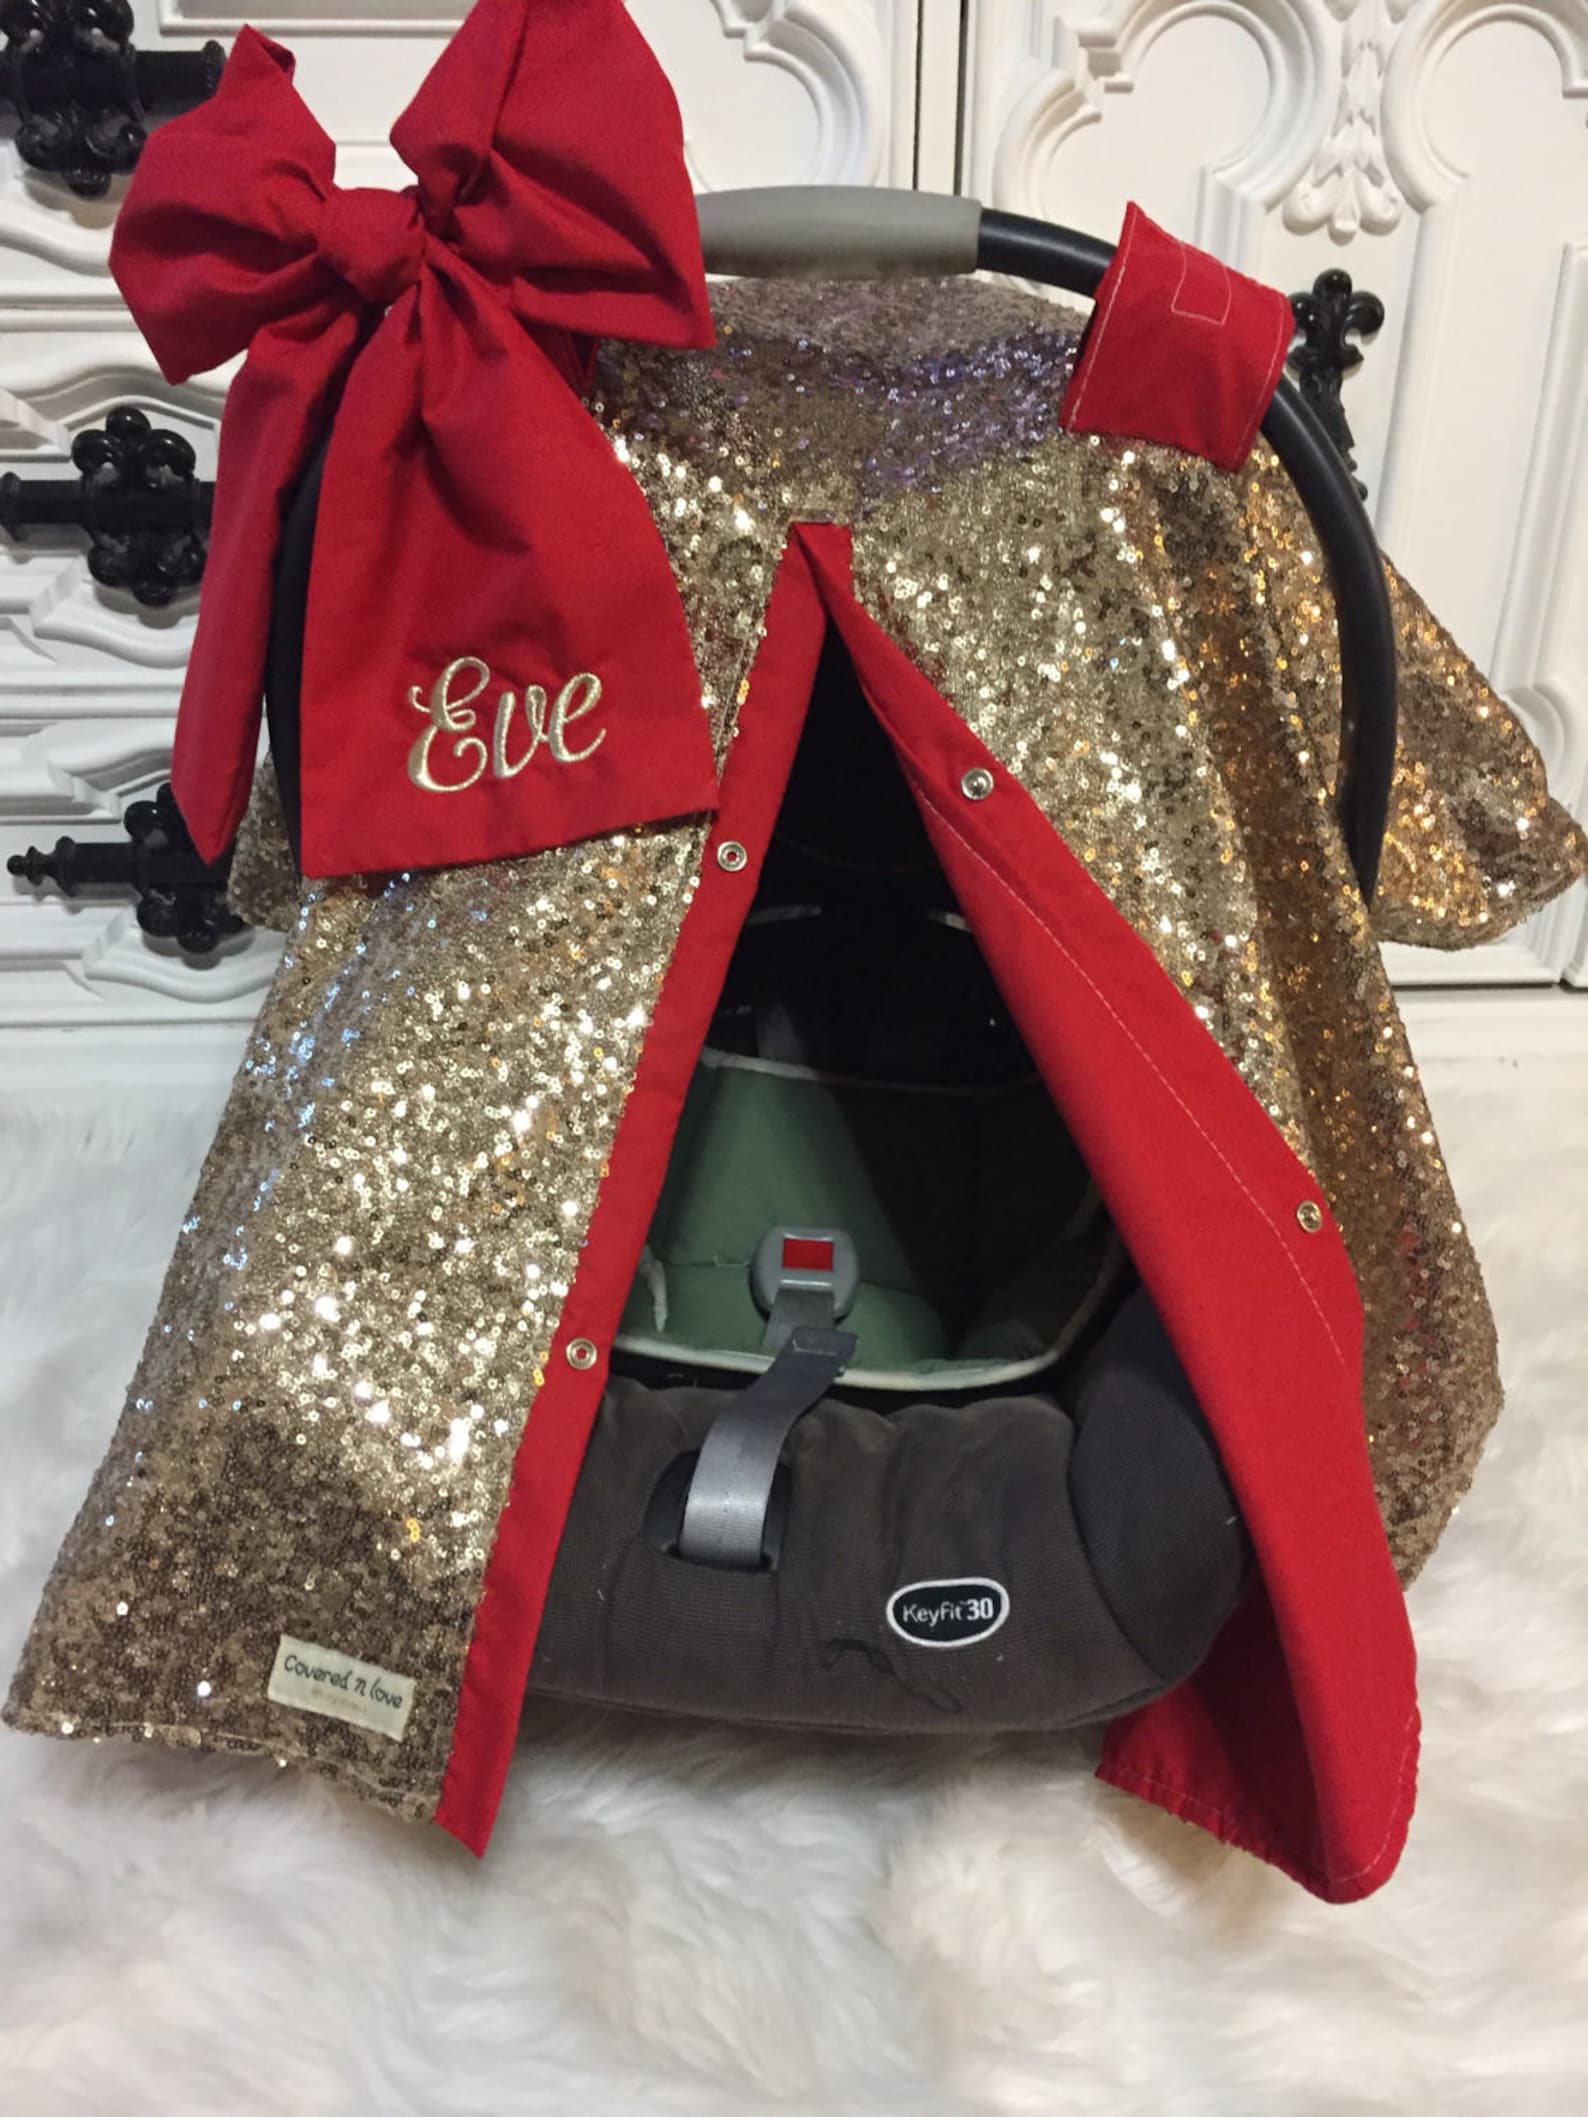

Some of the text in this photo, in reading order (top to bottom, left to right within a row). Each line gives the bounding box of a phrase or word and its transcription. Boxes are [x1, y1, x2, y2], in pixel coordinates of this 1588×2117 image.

[407, 656, 607, 793] Eve
[966, 1597, 994, 1621] 30
[284, 1654, 353, 1689] Covered
[370, 1677, 403, 1709] love
